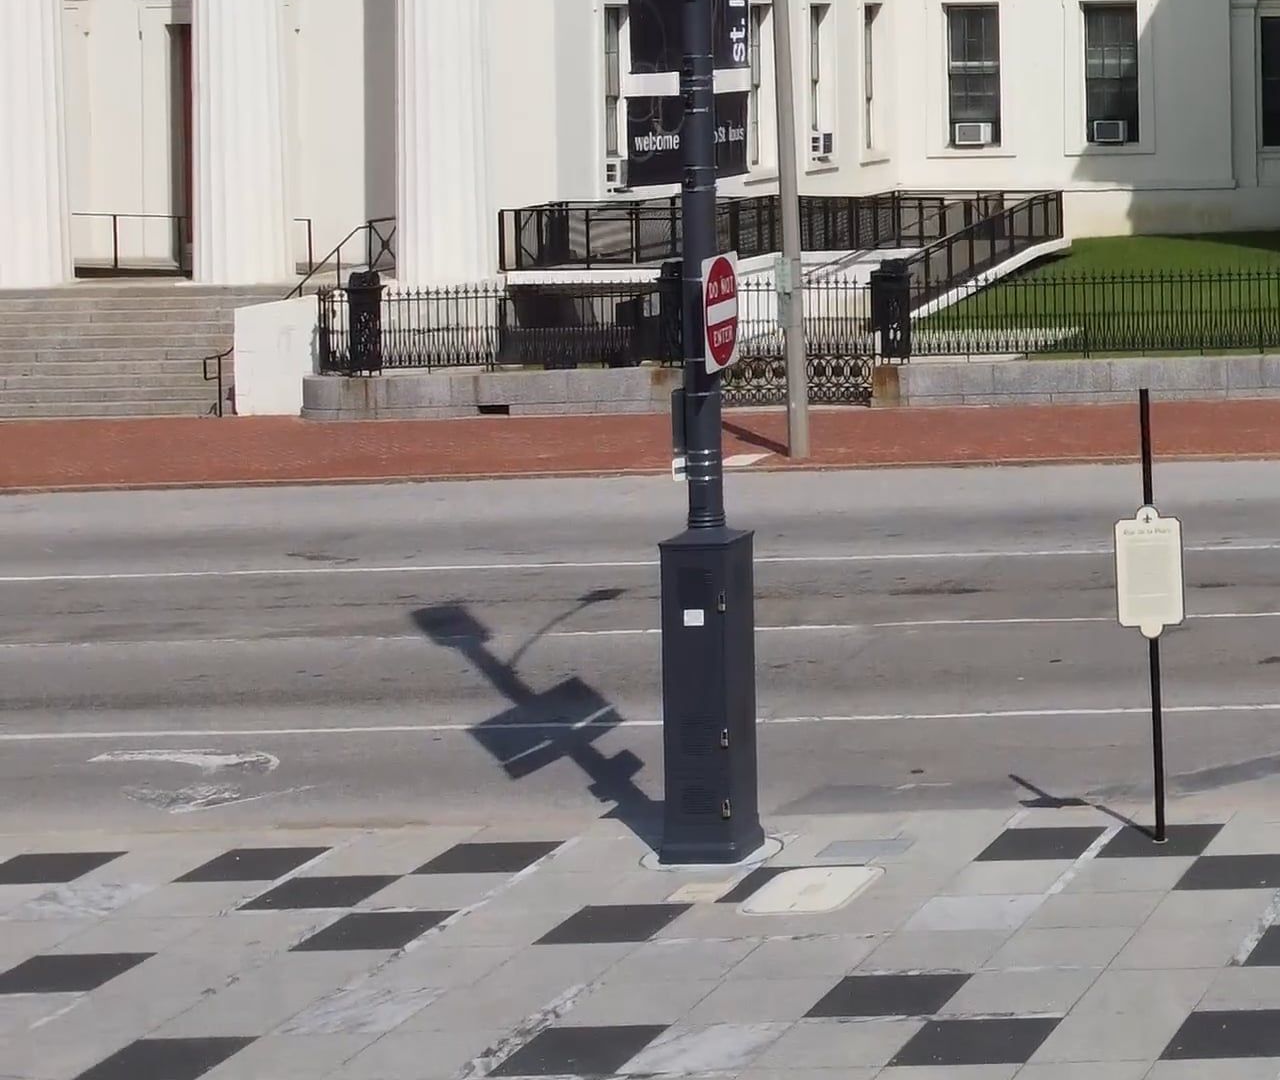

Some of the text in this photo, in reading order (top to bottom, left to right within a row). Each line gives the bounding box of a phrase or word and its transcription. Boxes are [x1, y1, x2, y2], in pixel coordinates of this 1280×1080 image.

[635, 131, 680, 152] welcome
[708, 276, 734, 299] DO NOT
[713, 325, 733, 348] ENTER
